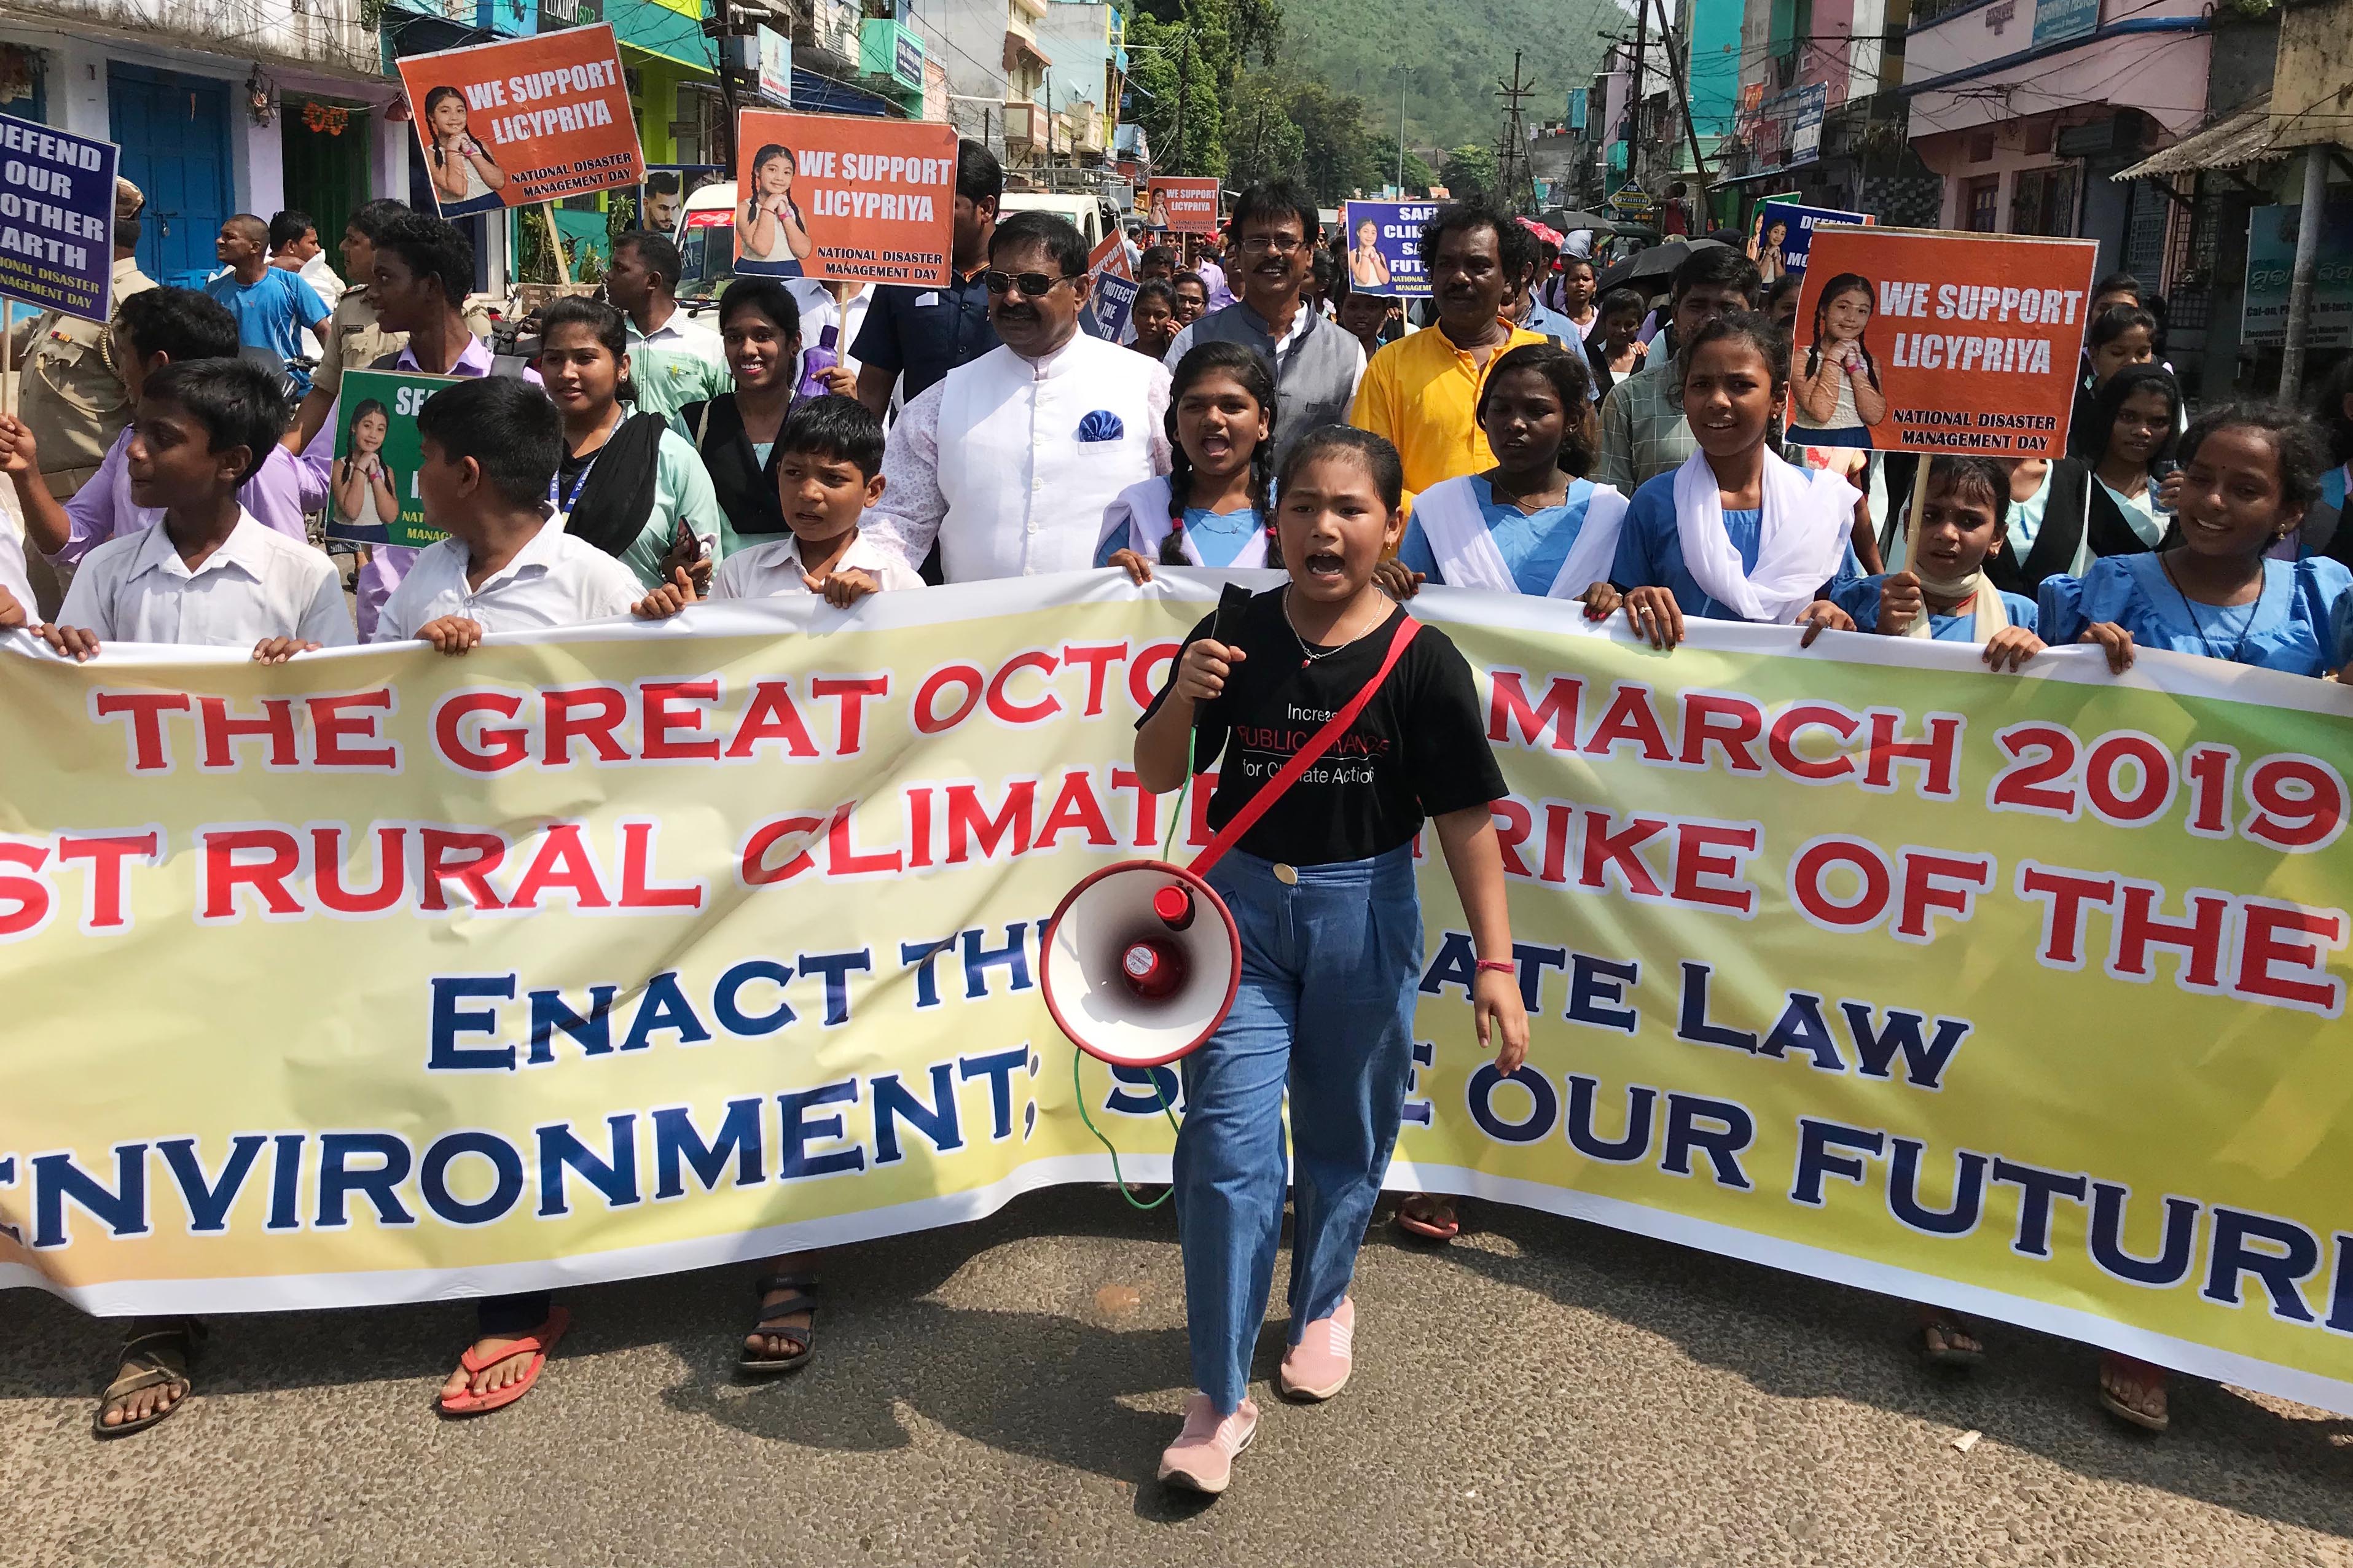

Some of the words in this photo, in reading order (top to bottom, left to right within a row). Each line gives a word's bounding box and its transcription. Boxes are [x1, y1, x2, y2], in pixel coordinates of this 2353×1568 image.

[465, 80, 508, 111] WE
[509, 59, 616, 103] SUPPORT
[491, 99, 613, 144] LICYPRIYA
[0, 123, 101, 172] EFEND
[5, 160, 72, 200] OUR
[511, 164, 571, 184] NATIONAL
[574, 152, 632, 173] DISASTER
[523, 173, 605, 197] MANAGEMENT
[608, 168, 632, 182] DAY
[799, 150, 836, 178] WE
[842, 153, 952, 185] SUPPORT
[813, 189, 934, 222] LICYPRIYA
[1166, 189, 1179, 198] WE
[1180, 189, 1216, 199] SUPPORT
[1171, 201, 1210, 211] LICYPRIYA
[0, 193, 104, 242] OTHER
[0, 225, 87, 270] ARTH
[817, 246, 879, 261] NATIONAL
[882, 251, 943, 265] DISASTER
[1088, 241, 1123, 281] SUPPORT
[0, 256, 35, 276] IONAL
[39, 268, 100, 294] DISASTER
[825, 262, 910, 278] MANAGEMENT
[914, 268, 939, 280] DAY
[0, 274, 64, 301] NAGEMENT
[67, 292, 92, 309] DAY
[1102, 301, 1118, 319] THE
[1880, 281, 1931, 318] WE
[1936, 284, 2083, 325] SUPPORT
[1892, 332, 2051, 374] LICYPRIYA
[1892, 408, 1973, 427] NATIONAL
[1977, 413, 2056, 430] DISASTER
[1901, 429, 2013, 450] MANAGEMENT
[2017, 435, 2050, 451] DAY
[96, 688, 396, 770] THE
[436, 674, 889, 773] GREAT
[914, 641, 1182, 734] OCTO
[1487, 670, 1960, 795] MARCH
[1994, 728, 2342, 846] 2019
[202, 824, 702, 918] RURAL
[1488, 798, 1756, 912] RIKE
[1795, 842, 1988, 937] OF
[2024, 867, 2339, 1010] THE
[428, 947, 871, 1071] ENACT
[901, 919, 1052, 1007] TH
[1678, 962, 1970, 1089] LAW
[0, 1043, 1039, 1248] NVIRONMENT;
[1468, 1063, 1755, 1188] OUR
